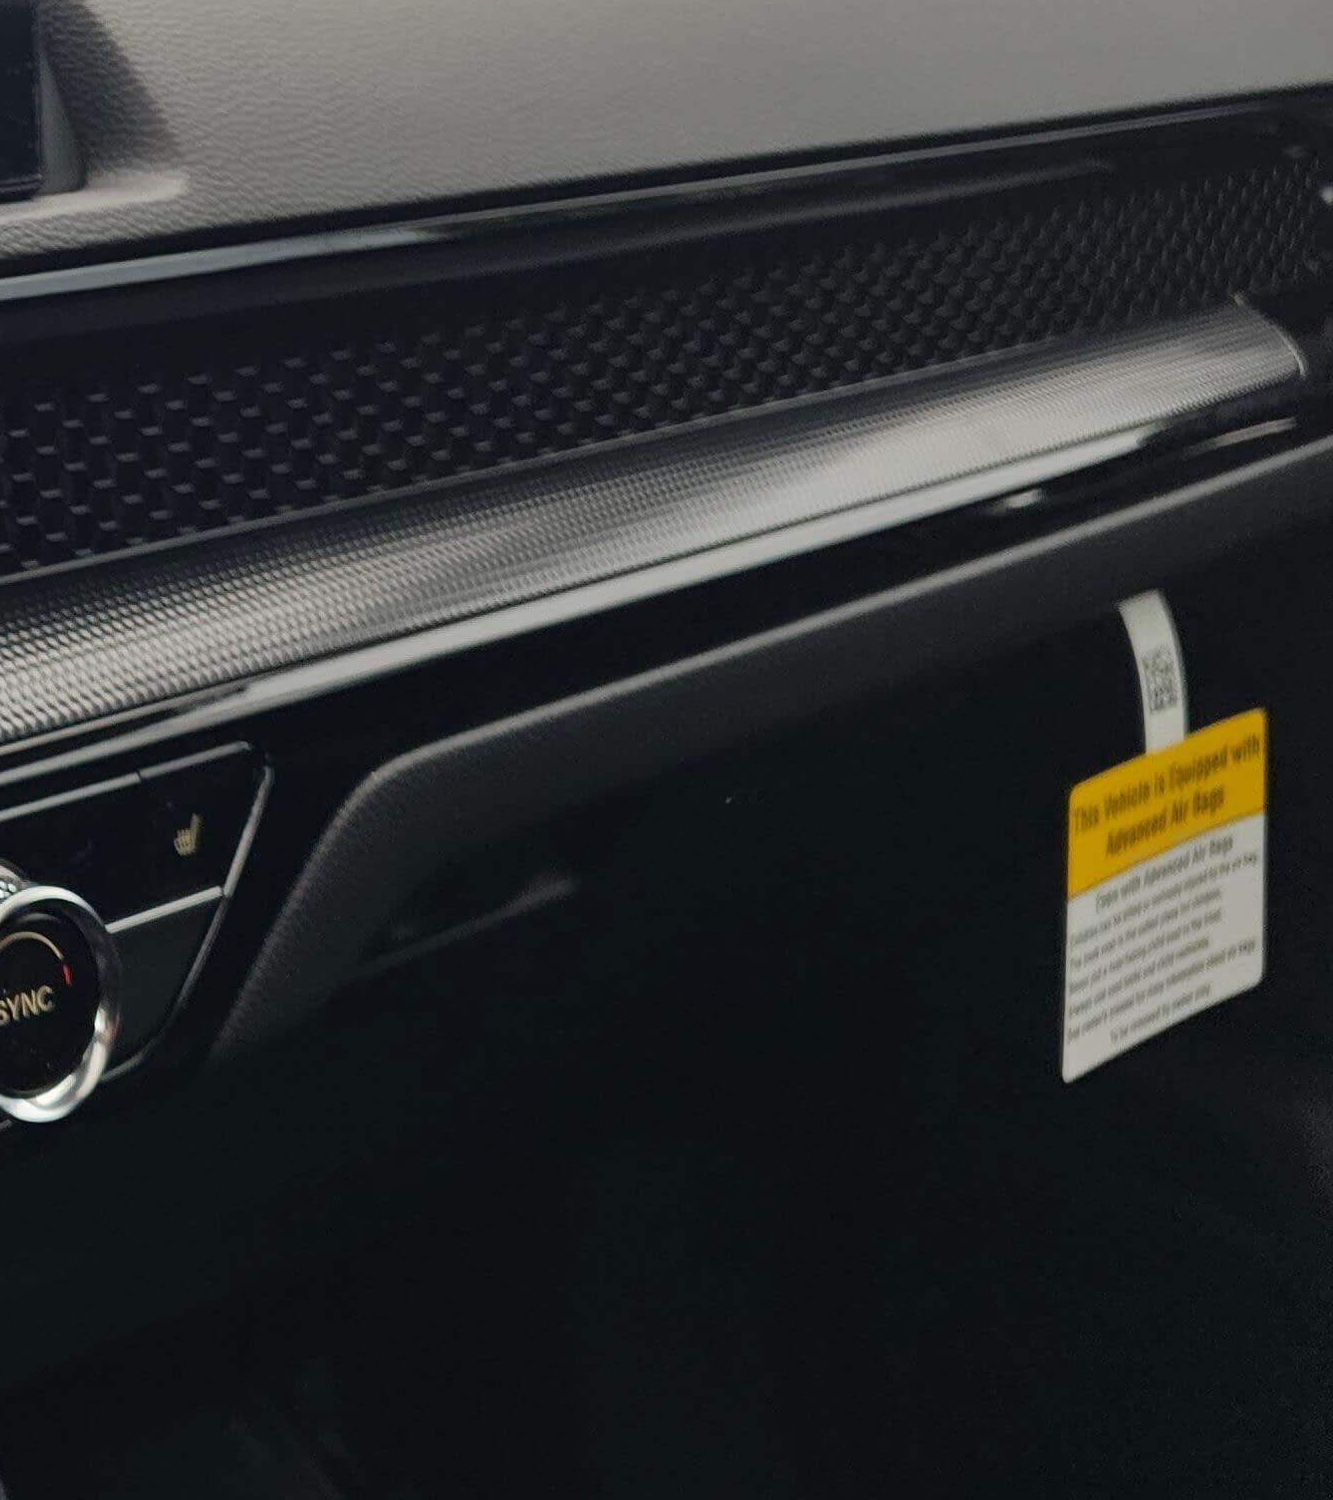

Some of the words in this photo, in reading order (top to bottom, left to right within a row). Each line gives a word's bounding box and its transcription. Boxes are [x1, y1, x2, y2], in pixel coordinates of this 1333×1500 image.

[1074, 803, 1100, 836] This
[1103, 779, 1151, 820] Vehicle
[1154, 771, 1166, 797] is
[1233, 732, 1260, 763] with
[1106, 806, 1168, 857] Advanced
[1171, 799, 1189, 825] Air
[1192, 784, 1225, 815] Bags
